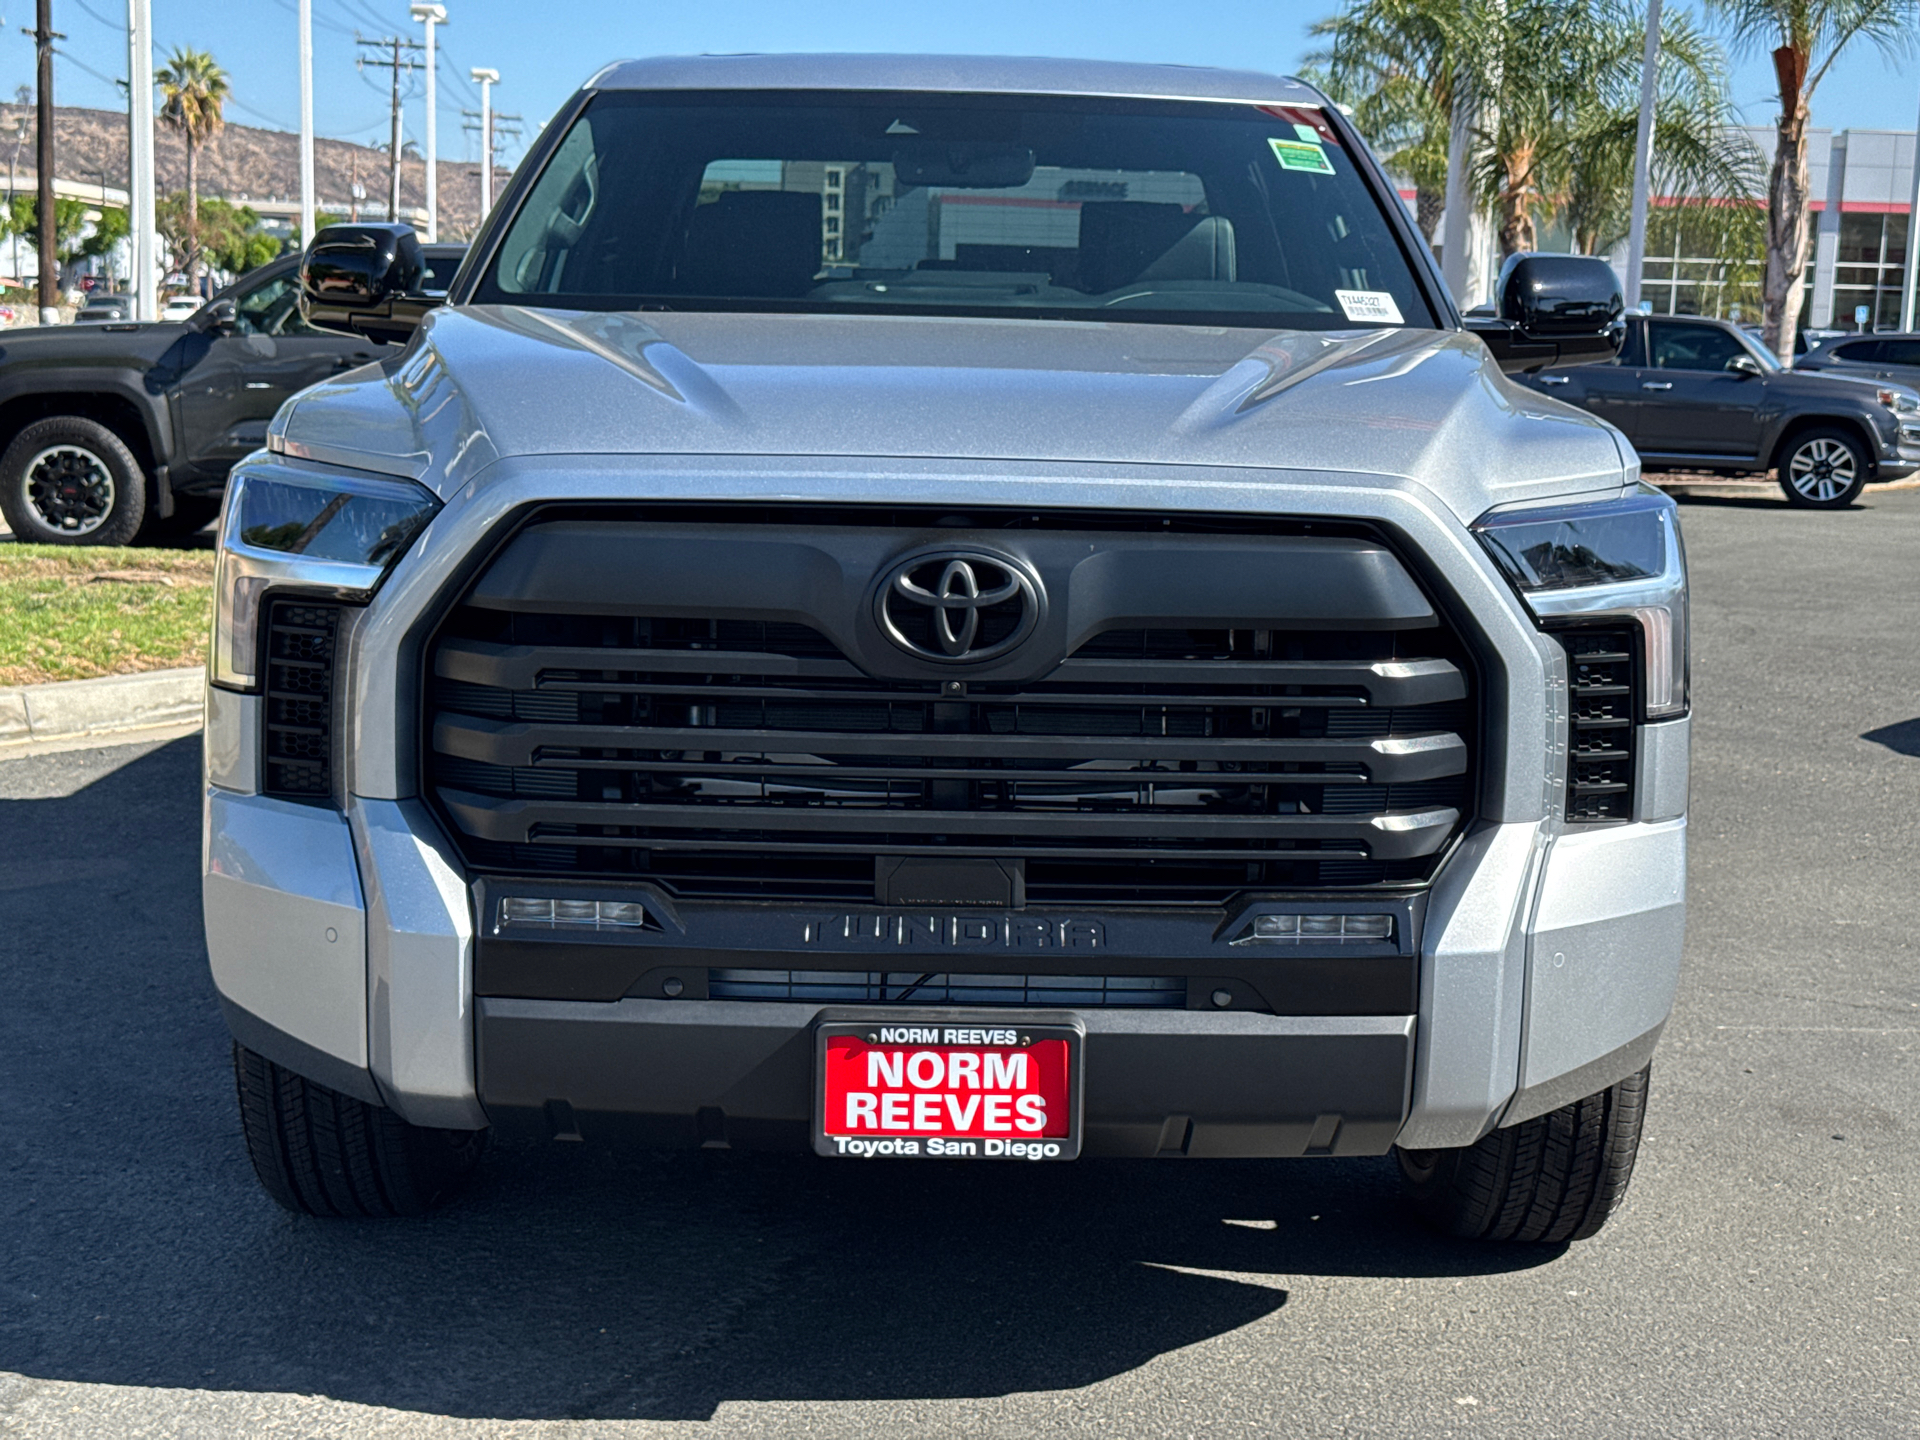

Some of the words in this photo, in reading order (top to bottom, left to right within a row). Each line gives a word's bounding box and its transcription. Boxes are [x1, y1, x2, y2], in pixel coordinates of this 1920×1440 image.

[791, 913, 1106, 947] TUNDRA
[881, 1028, 939, 1044] NORM
[944, 1029, 1017, 1045] REEVES
[867, 1051, 1028, 1090] NORM
[846, 1092, 1047, 1132] REEVES
[833, 1136, 919, 1158] Toyota
[926, 1138, 977, 1157] San
[984, 1139, 1060, 1160] Diego
